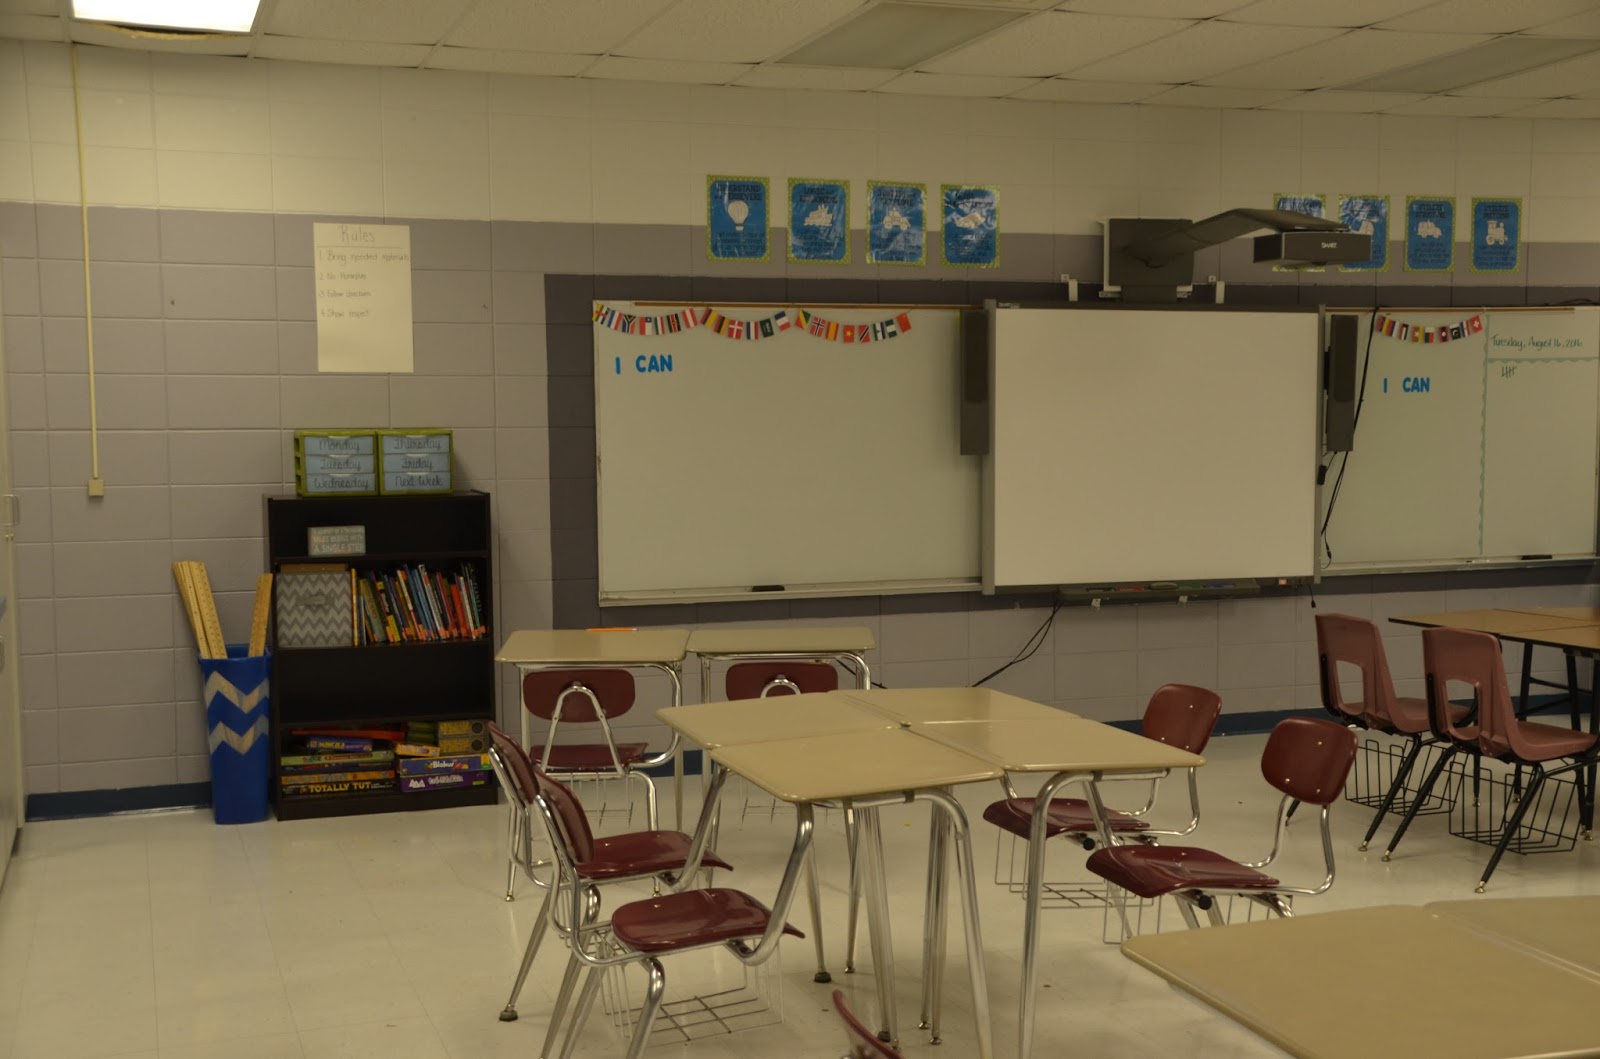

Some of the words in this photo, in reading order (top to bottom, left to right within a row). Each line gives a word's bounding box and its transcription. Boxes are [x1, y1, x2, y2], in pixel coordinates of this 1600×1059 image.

[338, 224, 376, 245] Rules
[327, 250, 347, 264] Bring
[351, 250, 378, 263] needed
[327, 271, 337, 280] No
[327, 308, 345, 319] Show
[1490, 336, 1526, 351] Tuesday,
[1528, 336, 1552, 350] August
[1566, 337, 1583, 347] 2016
[615, 356, 621, 375] I
[635, 354, 673, 373] CAN
[1383, 377, 1388, 393] I
[1402, 376, 1430, 393] CAN
[319, 438, 360, 451] Monday
[393, 436, 441, 450] Thursday
[320, 457, 361, 471] Tuesday
[401, 457, 433, 470] Friday
[314, 476, 369, 490] Wednesday
[395, 475, 418, 487] Next
[419, 474, 443, 487] Week
[308, 782, 350, 794] TOTALLY
[352, 781, 371, 790] TUT
